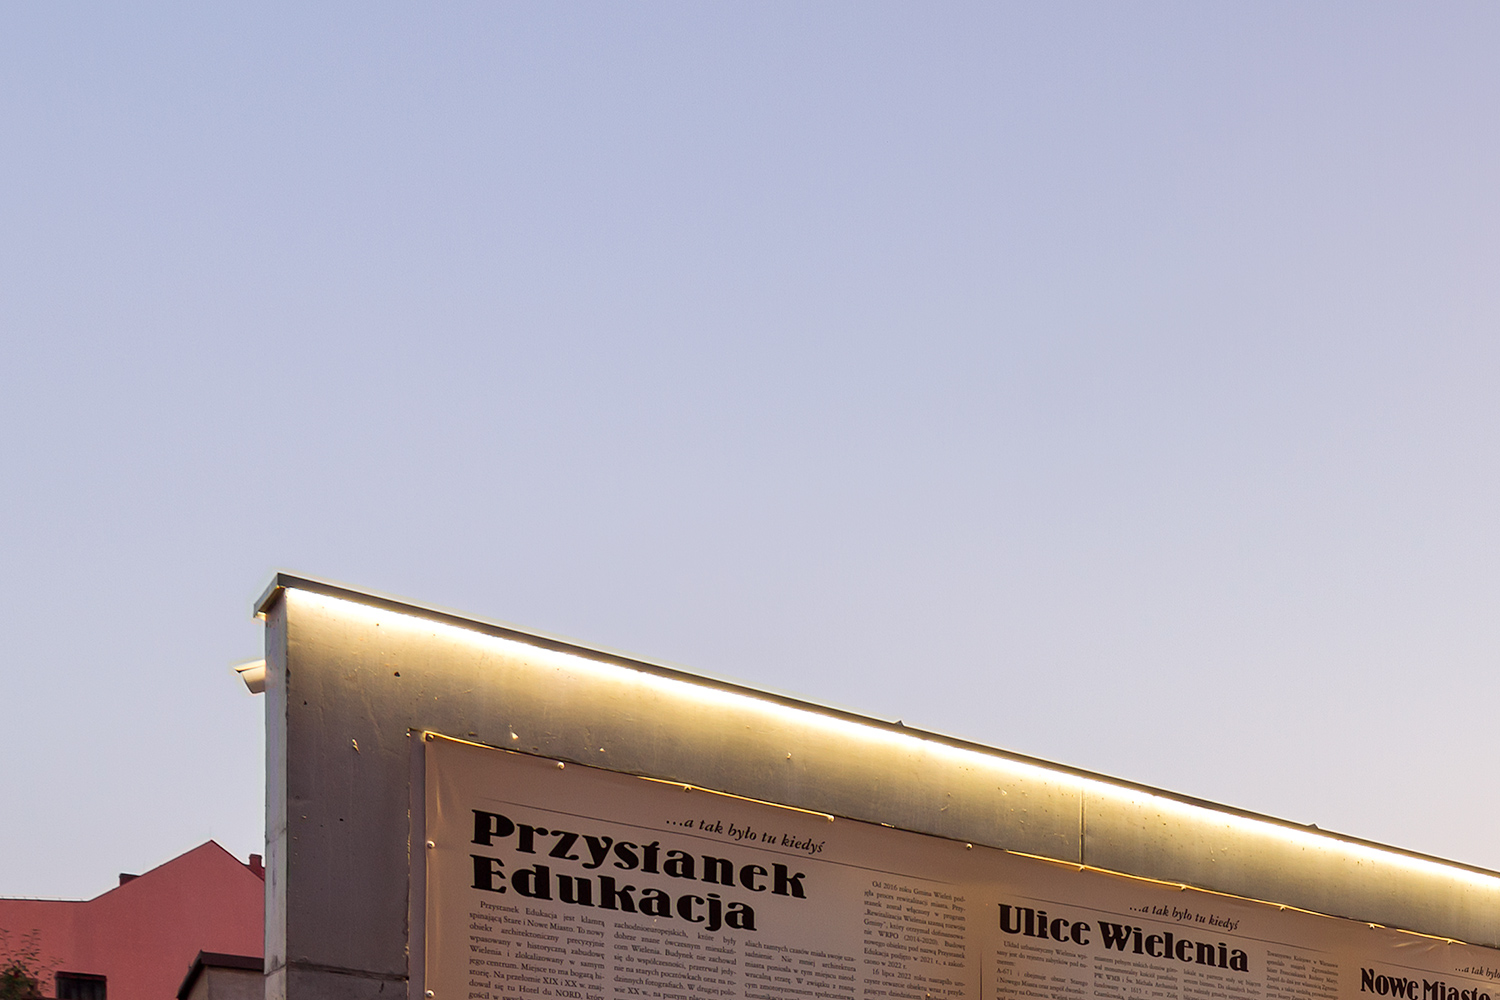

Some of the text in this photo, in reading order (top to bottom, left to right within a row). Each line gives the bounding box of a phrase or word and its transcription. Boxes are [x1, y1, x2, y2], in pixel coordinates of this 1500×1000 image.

[699, 820, 723, 834] tak
[728, 823, 757, 841] było
[761, 832, 777, 844] tu
[781, 833, 825, 854] kiedyś
[471, 809, 806, 898] Przystanek
[470, 854, 757, 932] Edukacja
[481, 901, 519, 913] Przystanek
[526, 908, 557, 919] Edukacja
[1152, 905, 1169, 917] tak
[1172, 907, 1192, 922] było
[1195, 913, 1206, 923] tu
[1208, 914, 1240, 931] kiedyś
[469, 922, 492, 931] obiekt
[567, 938, 604, 947] precyzyjnie
[504, 916, 521, 925] Stare
[527, 919, 548, 928] Nowe
[587, 930, 604, 938] nowy
[998, 904, 1249, 972] Ulice Wielenia
[470, 936, 510, 947] wpasowany
[470, 945, 502, 955] Wielenia
[515, 951, 563, 965] zlokalizowany
[521, 963, 547, 973] Miejsce
[1471, 966, 1484, 976] tak
[1485, 968, 1500, 980] było
[519, 985, 539, 994] Hotel
[543, 977, 558, 985] XIX
[1360, 968, 1419, 1000] Nowe
